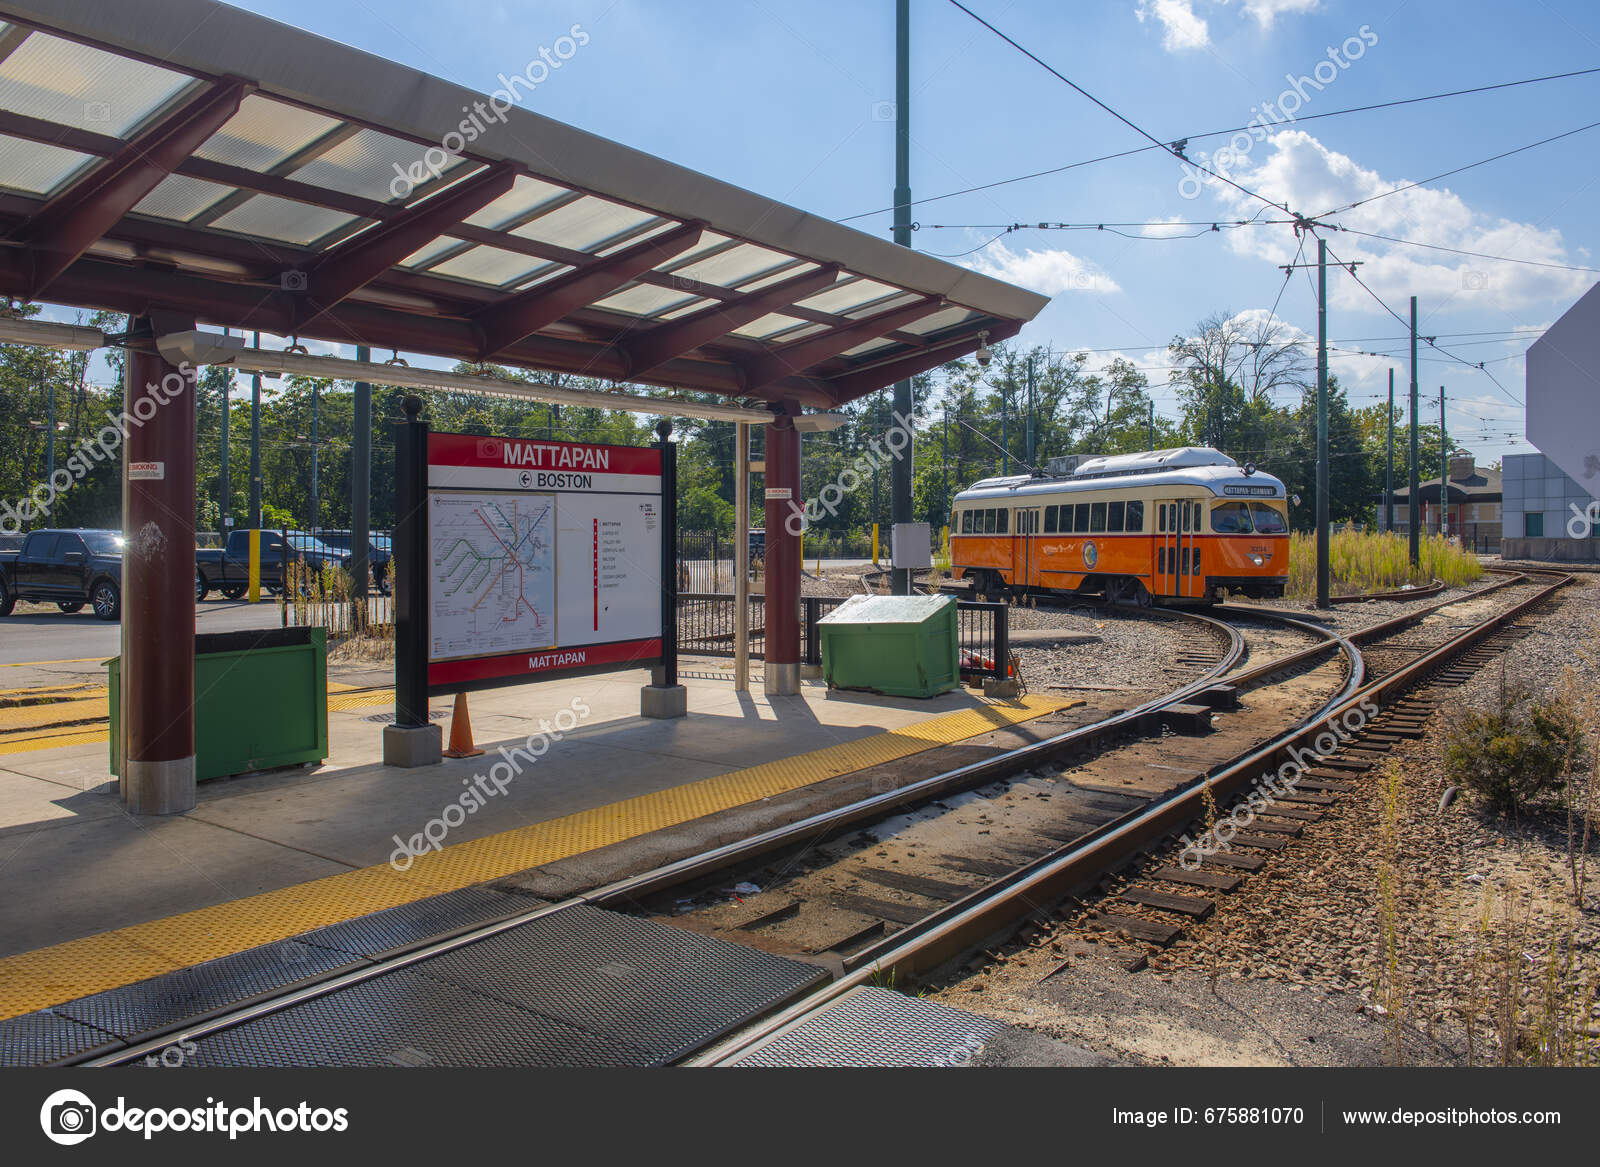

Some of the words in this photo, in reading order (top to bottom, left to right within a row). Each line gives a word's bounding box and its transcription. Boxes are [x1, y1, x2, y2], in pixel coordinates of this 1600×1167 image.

[504, 442, 609, 469] MATTAPAN
[537, 472, 592, 488] BOSTON
[529, 651, 586, 669] MATTAPAN
